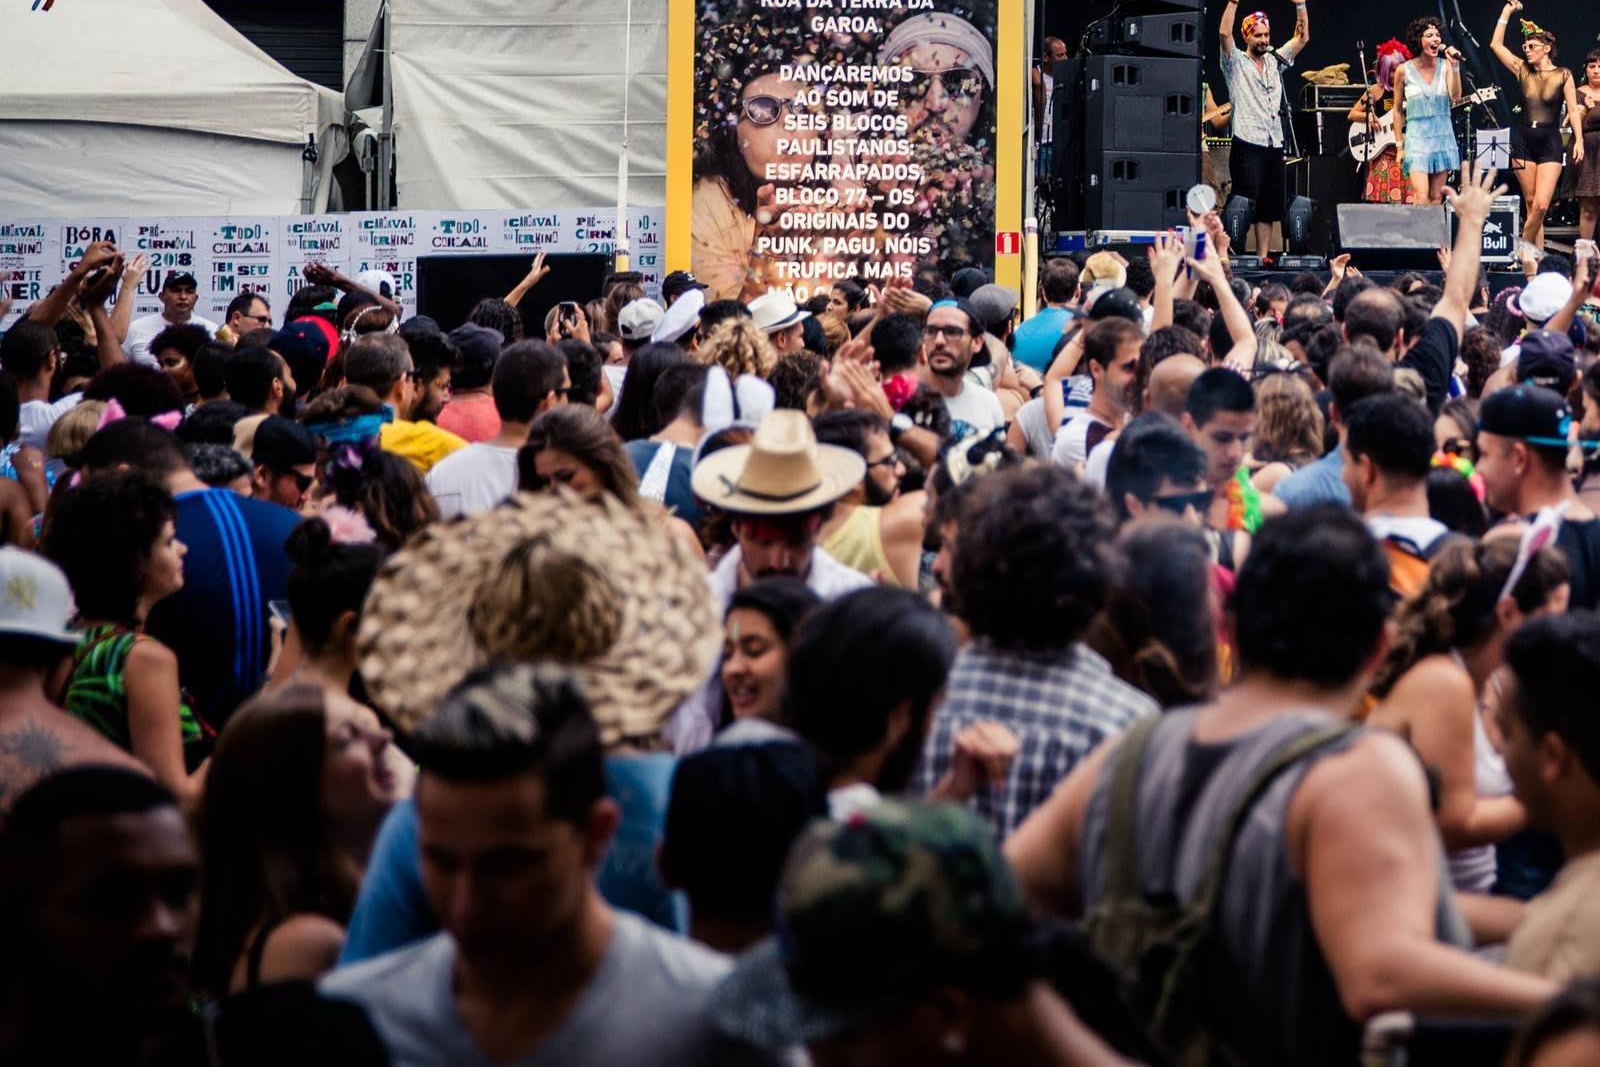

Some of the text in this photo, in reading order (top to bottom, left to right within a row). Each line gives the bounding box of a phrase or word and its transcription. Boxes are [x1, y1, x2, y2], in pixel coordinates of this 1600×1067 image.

[811, 16, 884, 34] GAROA.
[780, 65, 914, 87] DANÇAREMOS
[793, 89, 899, 108] AO SOM DE
[784, 114, 909, 132] SEIS BLOCOS
[776, 138, 915, 157] PAULISTANOS:
[765, 163, 925, 183] ESFARRAPADOS,
[776, 187, 840, 206] BLOCO
[845, 188, 867, 206] 77
[889, 188, 914, 206] OS
[780, 212, 910, 231] ORIGINAIS DO
[758, 232, 932, 256] PUNK, PAGU, NÓIS
[151, 253, 193, 267] 2018
[775, 261, 913, 279] TRUPICA MAIS
